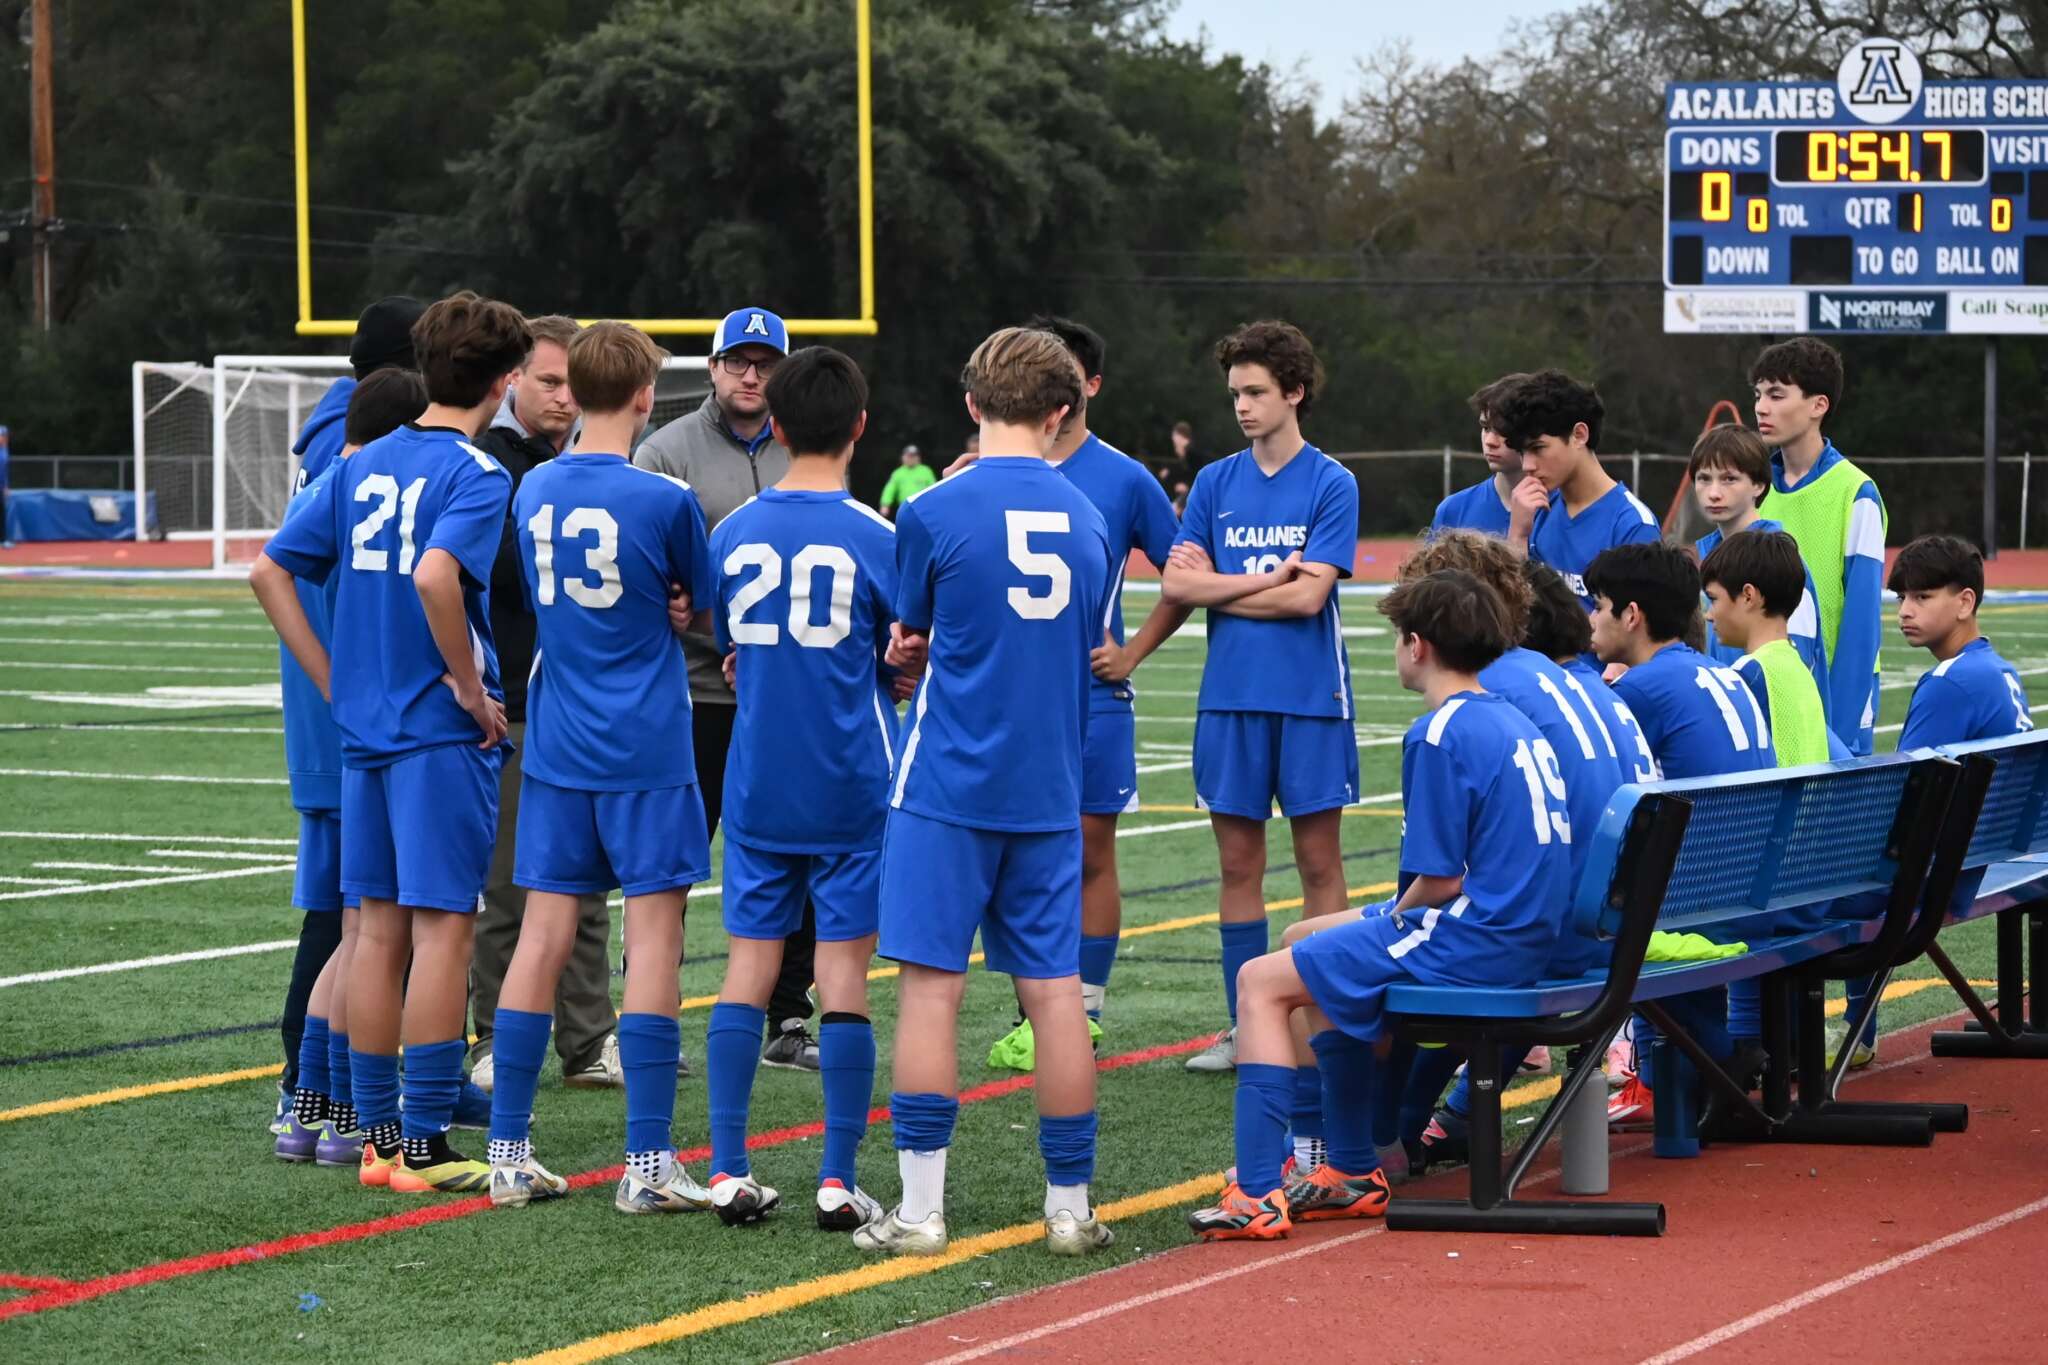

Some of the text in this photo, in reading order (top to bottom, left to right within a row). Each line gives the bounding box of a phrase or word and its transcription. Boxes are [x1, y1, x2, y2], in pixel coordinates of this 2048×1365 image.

[1850, 46, 1911, 104] A
[1669, 88, 1835, 120] ACALANES
[1924, 86, 2048, 118] HIGH SCH
[1681, 137, 1760, 165] DONS
[1807, 131, 1951, 183] 0:54.7
[1701, 172, 1731, 222] 0
[1845, 197, 1891, 228] QTR
[1913, 193, 1922, 232] 1
[1747, 198, 1768, 232] 0
[1776, 204, 1808, 228] TOL
[1950, 204, 1982, 228] TOL
[1991, 198, 2012, 232] 0
[1707, 247, 1769, 275] DOWN
[1857, 247, 1919, 275] TO GO
[1936, 247, 2019, 275] BALL ON
[1844, 301, 1935, 317] NORTHBAY
[1962, 298, 1997, 315] Cali
[744, 313, 769, 337] A
[1857, 317, 1922, 330] NETWORKS
[352, 473, 428, 575] 21
[1224, 526, 1307, 548] ACALANES
[528, 504, 623, 609] 13
[1004, 510, 1071, 620] 5
[723, 543, 857, 648] 20
[1535, 669, 1617, 760] 11
[1695, 665, 1769, 752] 17
[1512, 738, 1571, 845] 19
